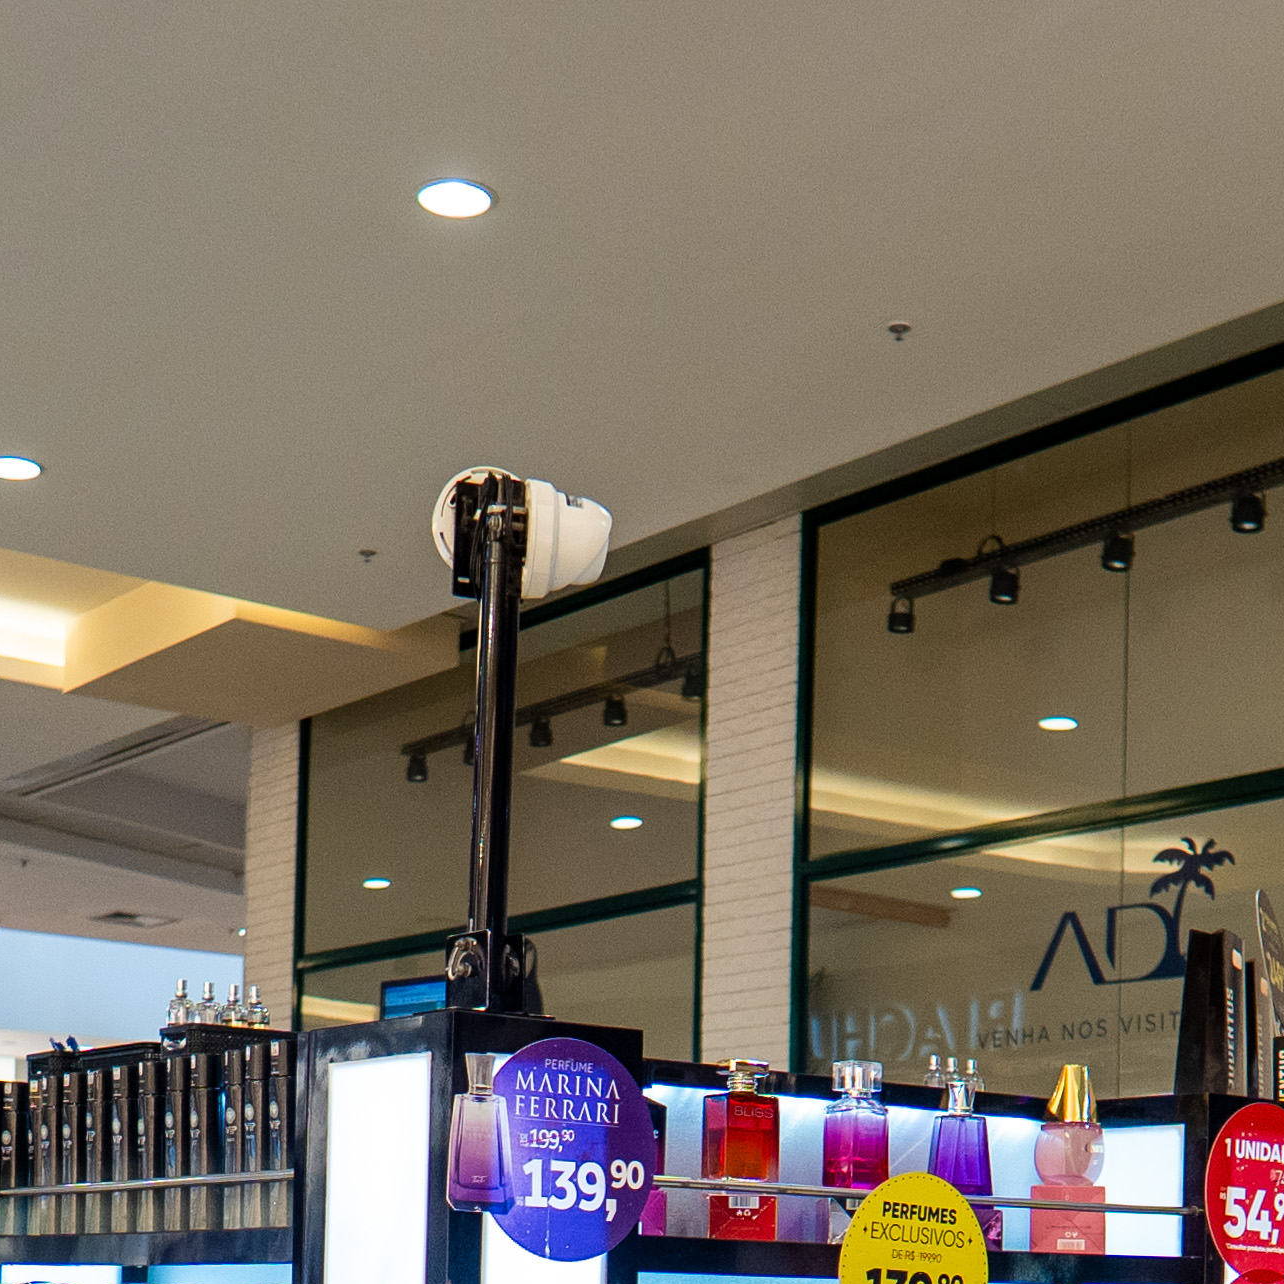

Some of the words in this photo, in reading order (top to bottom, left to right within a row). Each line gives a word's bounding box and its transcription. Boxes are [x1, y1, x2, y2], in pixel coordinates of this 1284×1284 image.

[977, 1026, 1050, 1049] VENHA
[1062, 1018, 1108, 1041] NOS
[1120, 1011, 1181, 1034] VISIT
[544, 1058, 594, 1074] PERFUME
[515, 1069, 621, 1099] MARINA
[515, 1095, 620, 1124] FERRARI
[734, 1106, 774, 1119] BLISS
[1225, 1138, 1232, 1157] 1
[522, 1158, 645, 1222] 139,90
[882, 1201, 957, 1225] PERFUMES
[870, 1221, 965, 1248] EXCLUSIVOS
[892, 1249, 903, 1260] DE
